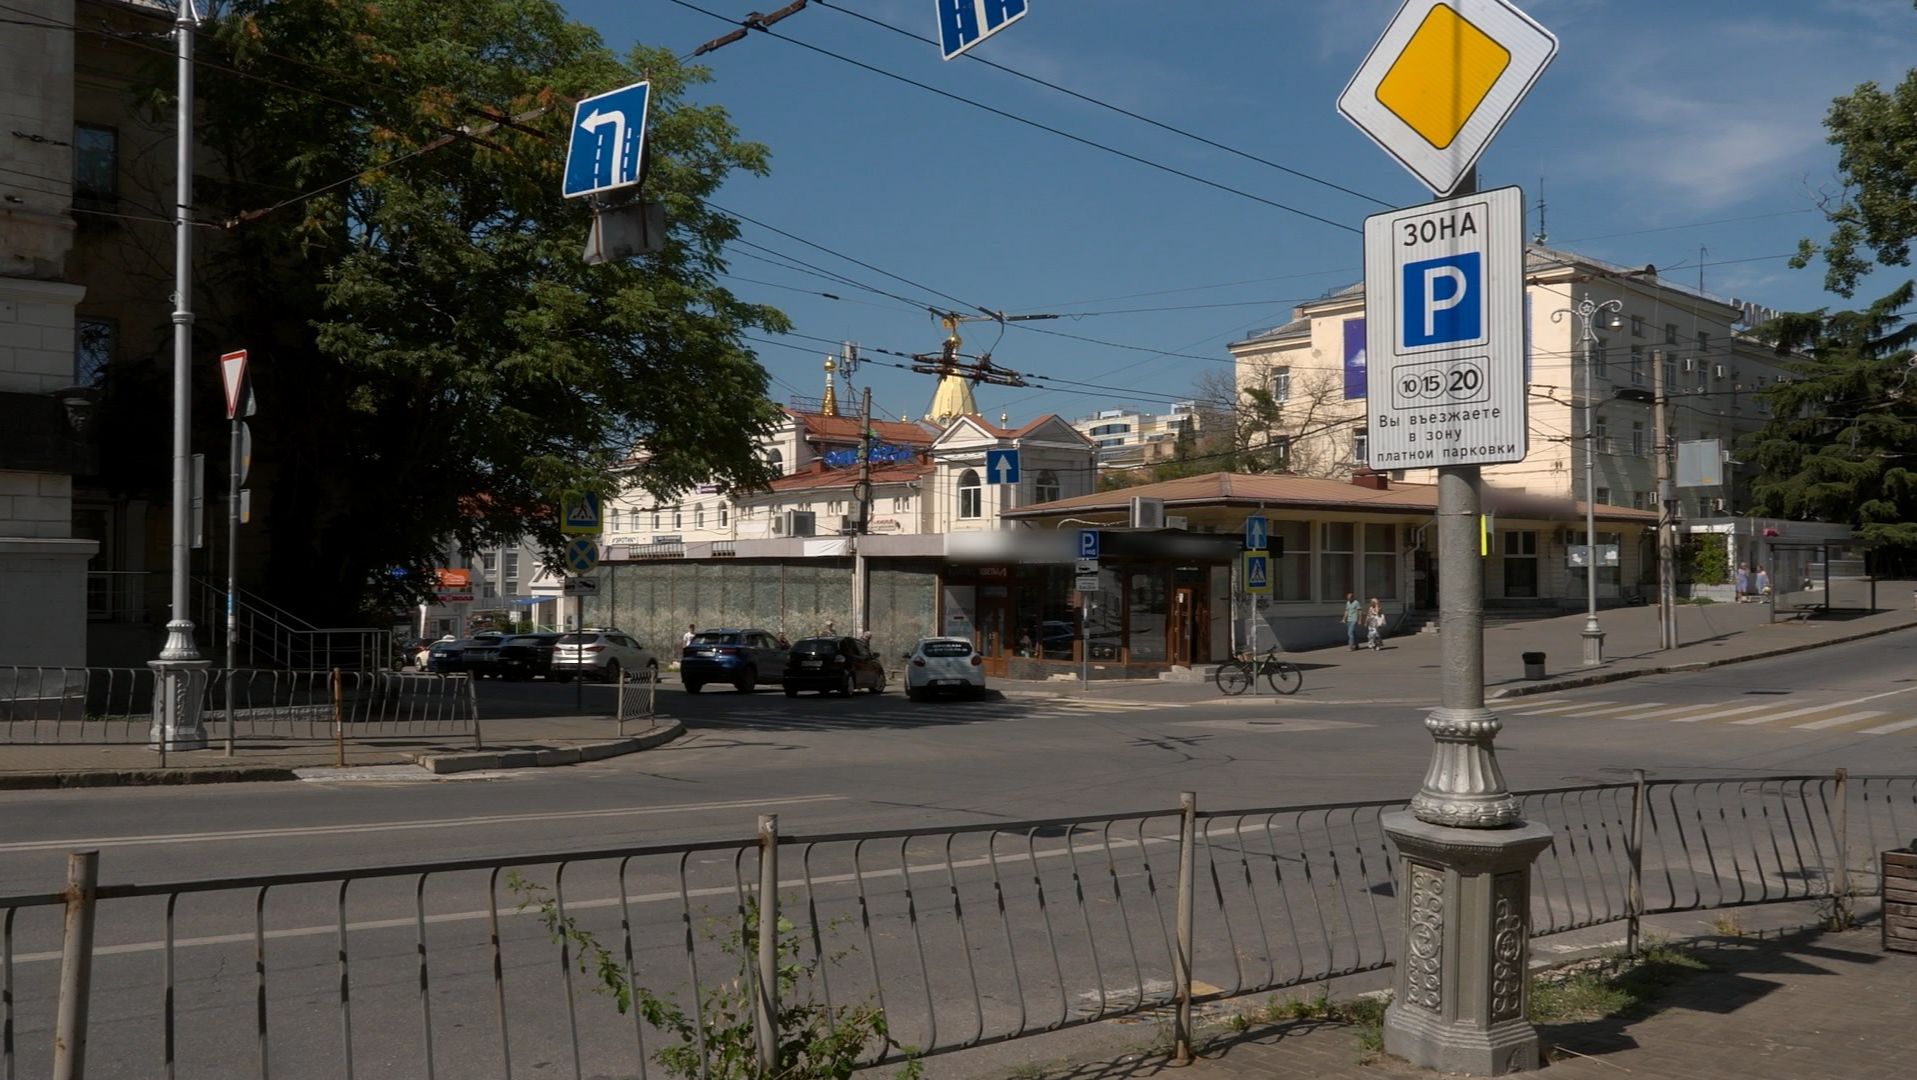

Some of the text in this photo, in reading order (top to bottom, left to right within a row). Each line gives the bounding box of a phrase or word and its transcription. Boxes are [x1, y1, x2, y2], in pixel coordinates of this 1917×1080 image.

[1403, 212, 1477, 247] ЗОНА
[1402, 369, 1479, 394] 10 15 20
[1379, 407, 1501, 428] Вы въезжаете
[1409, 427, 1462, 442] в зону
[1442, 444, 1516, 460] парковки
